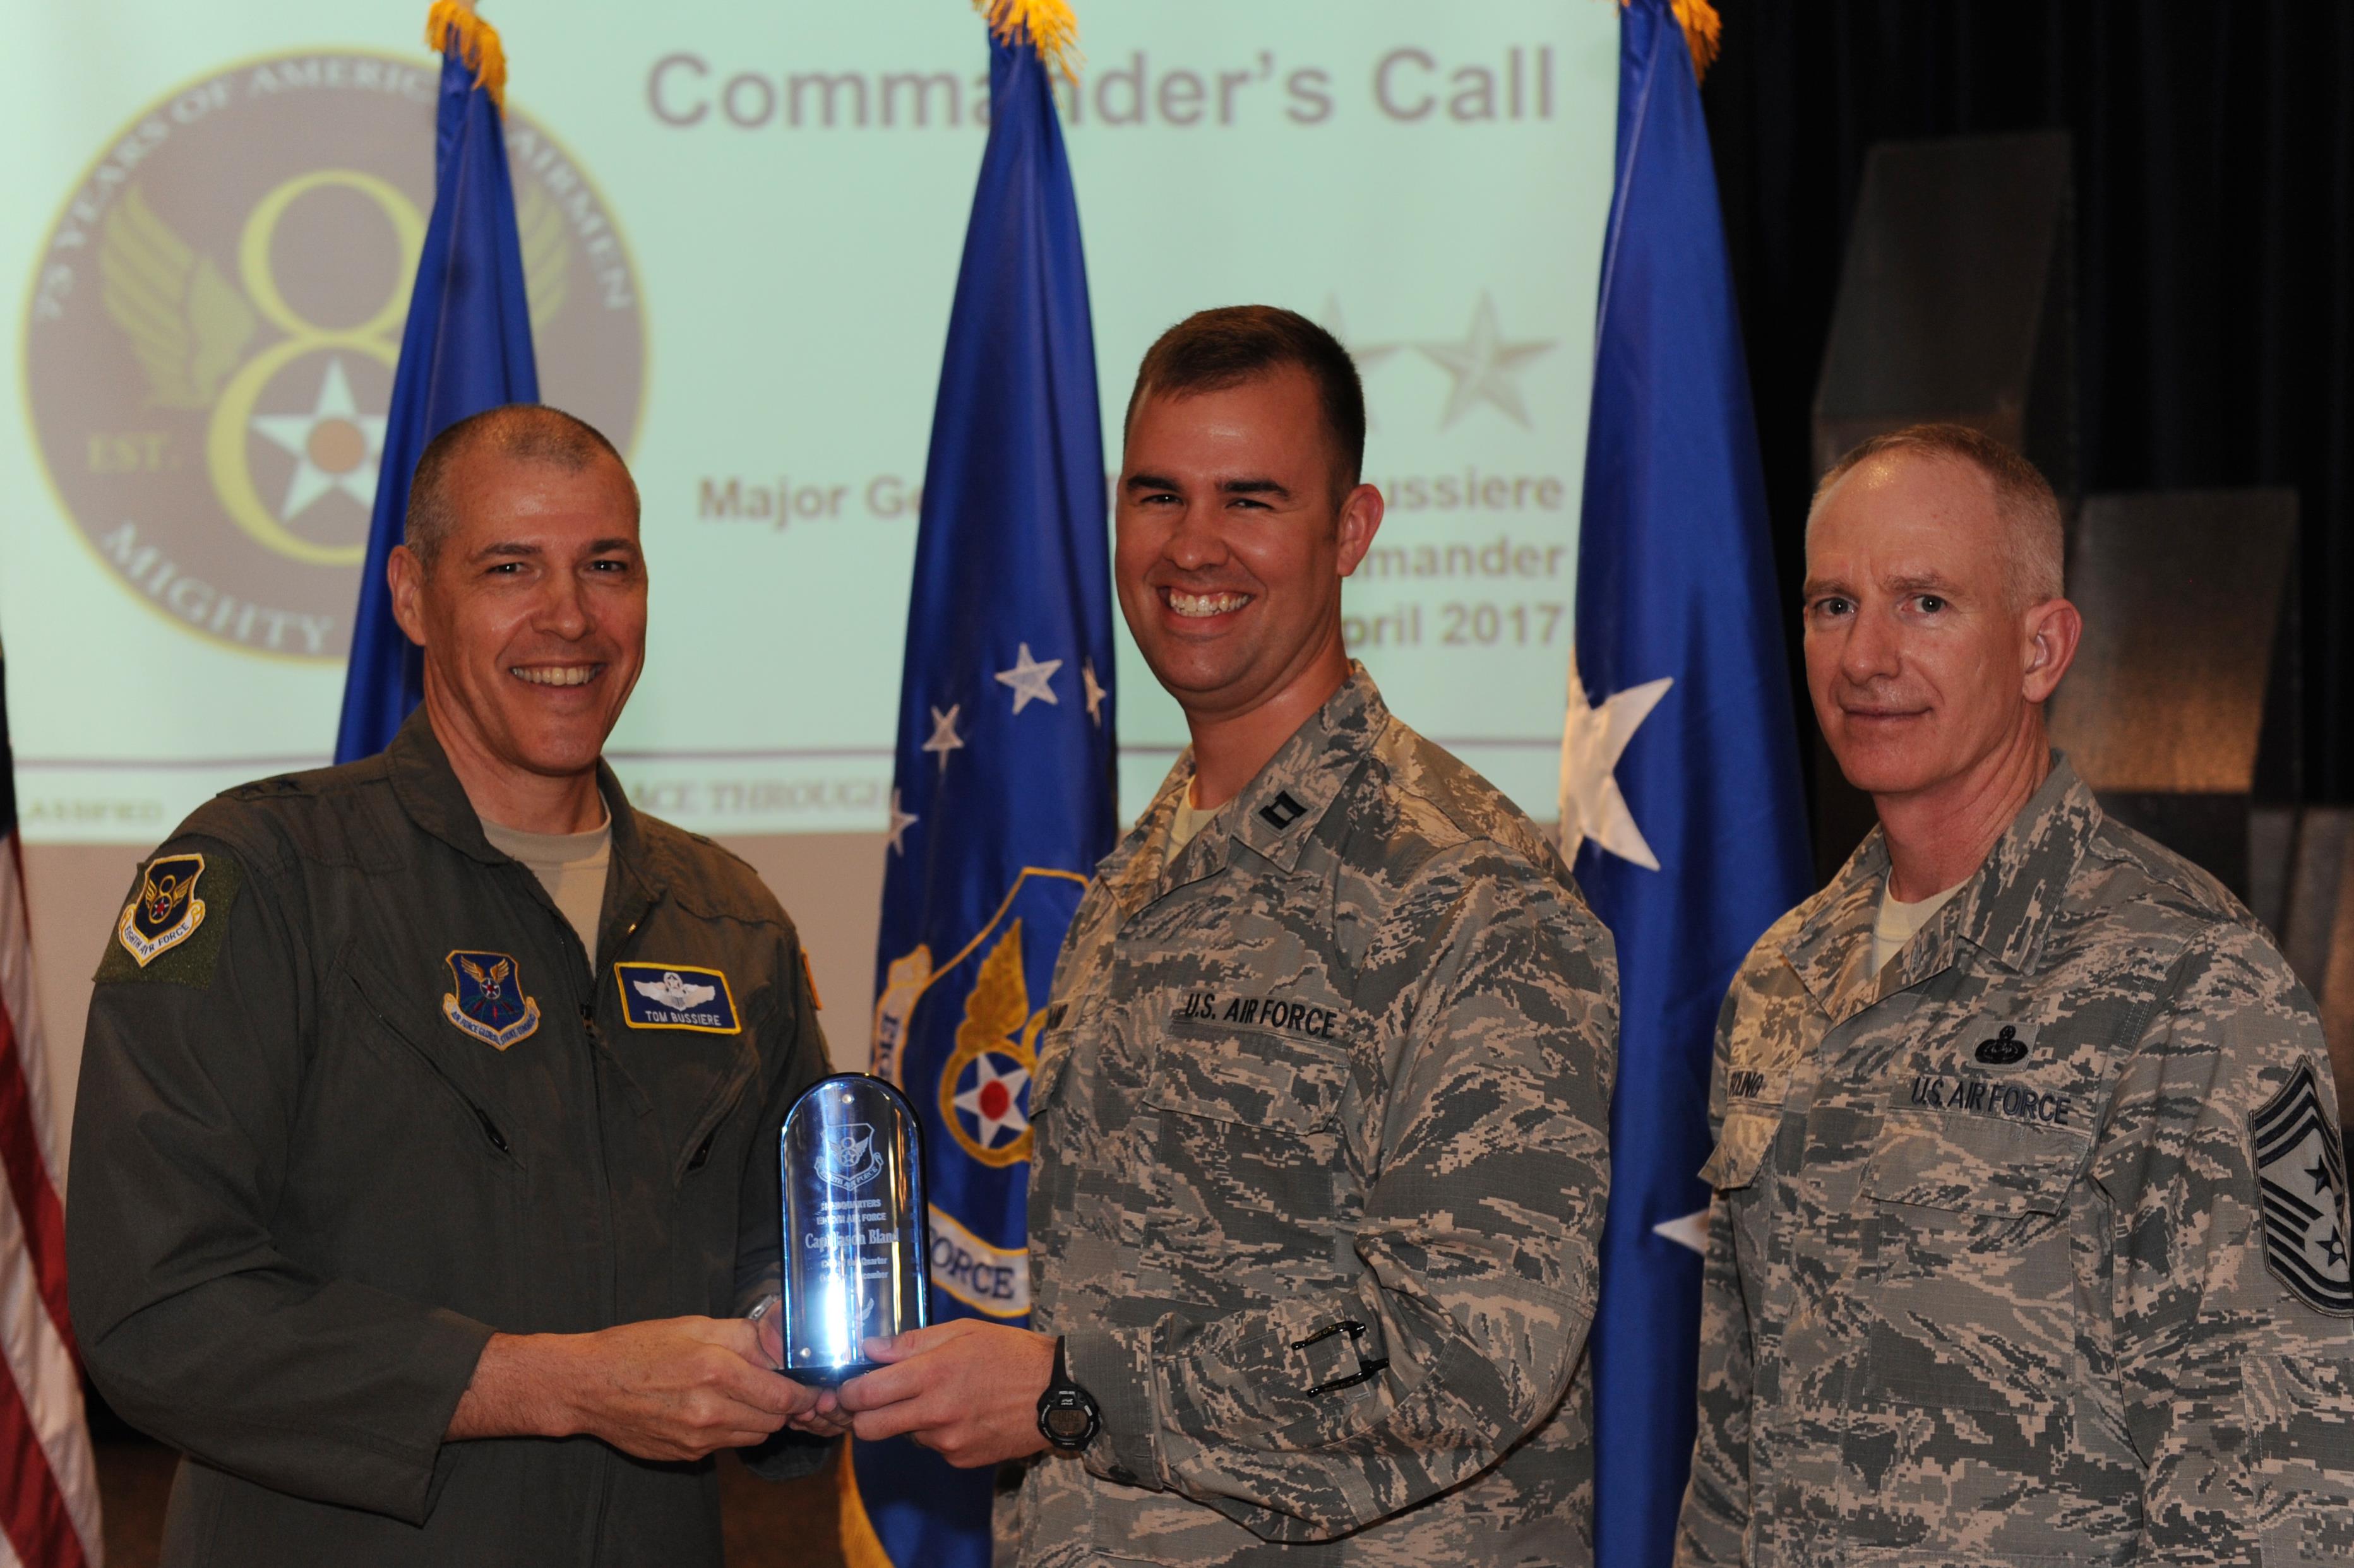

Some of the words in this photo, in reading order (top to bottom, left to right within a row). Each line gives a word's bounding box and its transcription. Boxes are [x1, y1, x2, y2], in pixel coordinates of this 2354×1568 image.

[1373, 46, 1553, 122] Call
[54, 120, 169, 251] YEARS
[170, 80, 232, 125] OF
[249, 57, 439, 106] AMERIC
[509, 128, 633, 311] AIRMEN
[698, 477, 848, 532] Major
[1384, 466, 1563, 511] ussiere
[1359, 537, 1568, 578] mander
[103, 521, 334, 654] MIGHTY
[1342, 603, 1422, 650] pril
[1440, 603, 1565, 648] 2017
[124, 925, 143, 949] EIGHTH
[138, 943, 155, 955] AIR
[158, 922, 189, 947] FORCE
[645, 1011, 668, 1023] TOM
[671, 1012, 722, 1026] BUSSIERE
[1185, 992, 1216, 1020] U.S.
[1223, 998, 1258, 1024] AIR
[1259, 999, 1338, 1039] FORCE
[1911, 1076, 1943, 1106] U.S.
[1947, 1081, 1986, 1111] AIR
[1989, 1084, 2072, 1126] FORCE
[856, 1167, 878, 1184] FORCE
[861, 1213, 887, 1222] FORCE
[804, 1232, 833, 1253] Cap
[868, 1228, 899, 1244] Bland
[861, 1256, 888, 1266] Quarter
